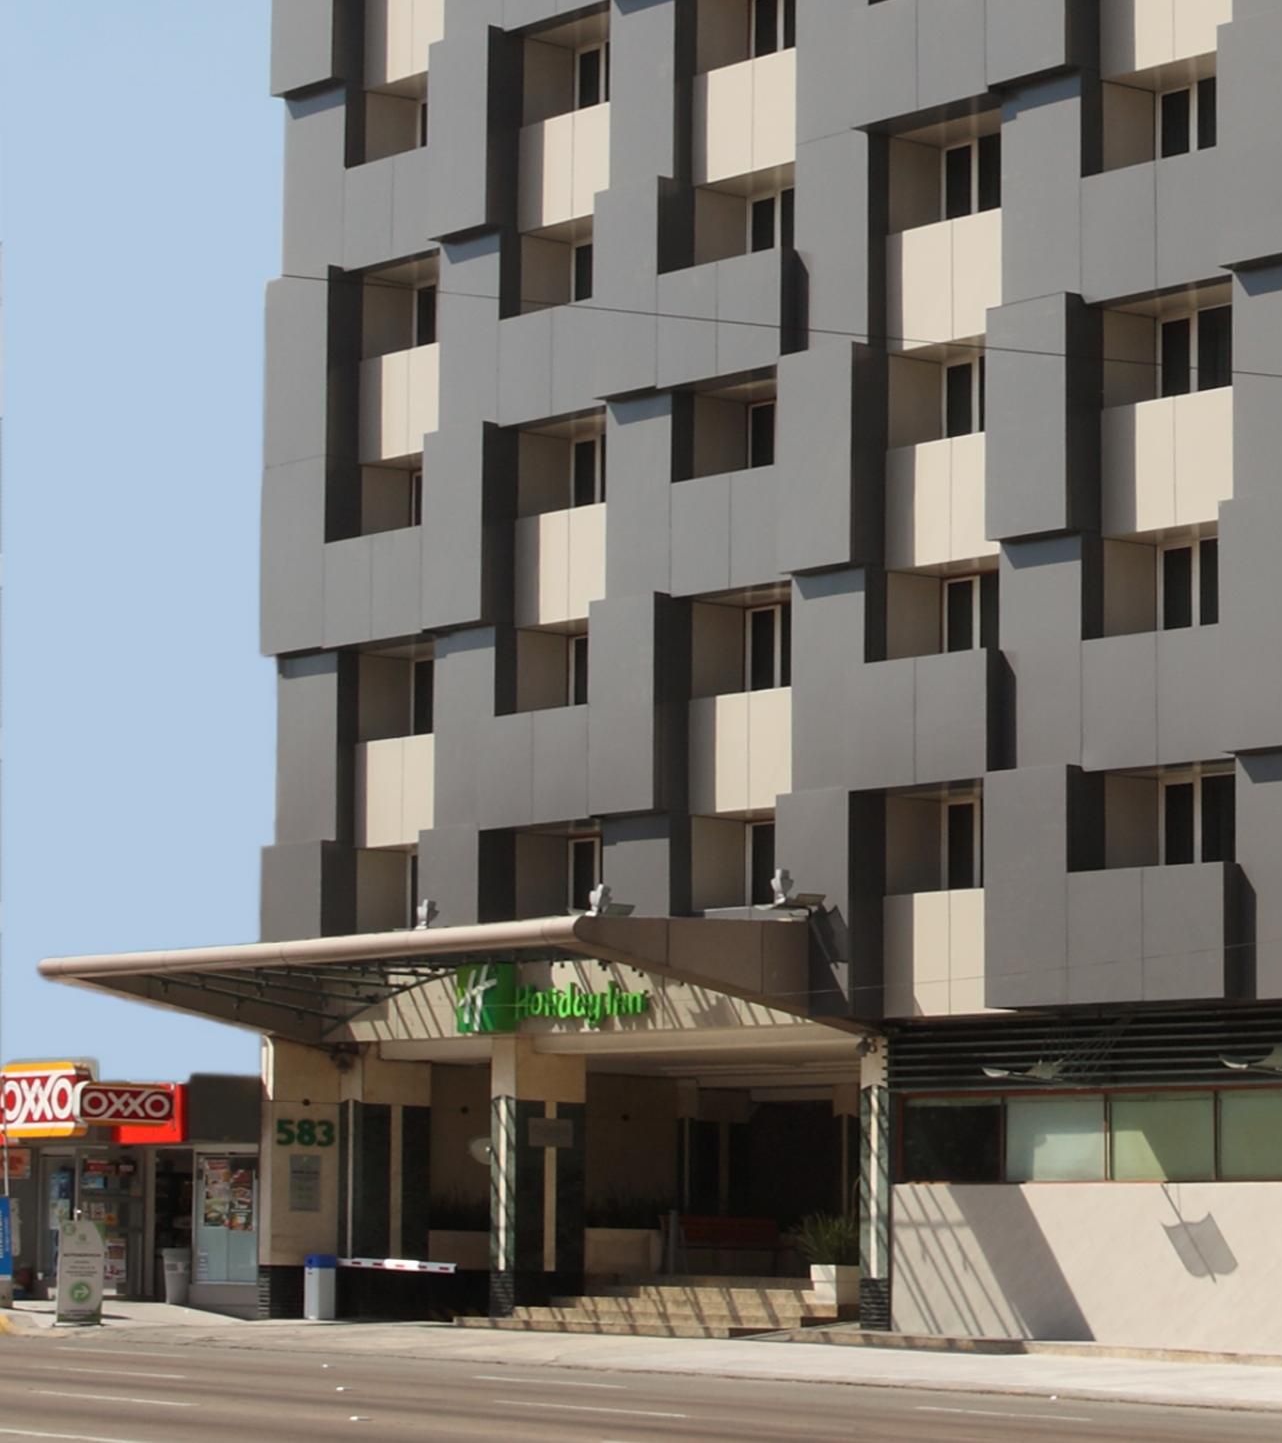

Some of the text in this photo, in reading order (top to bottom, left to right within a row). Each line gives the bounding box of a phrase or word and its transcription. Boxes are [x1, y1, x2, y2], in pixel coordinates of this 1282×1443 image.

[515, 980, 649, 1028] Holiday Inn
[4, 1074, 74, 1124] OXXO
[83, 1090, 171, 1119] OXXO
[276, 1118, 336, 1147] 583
